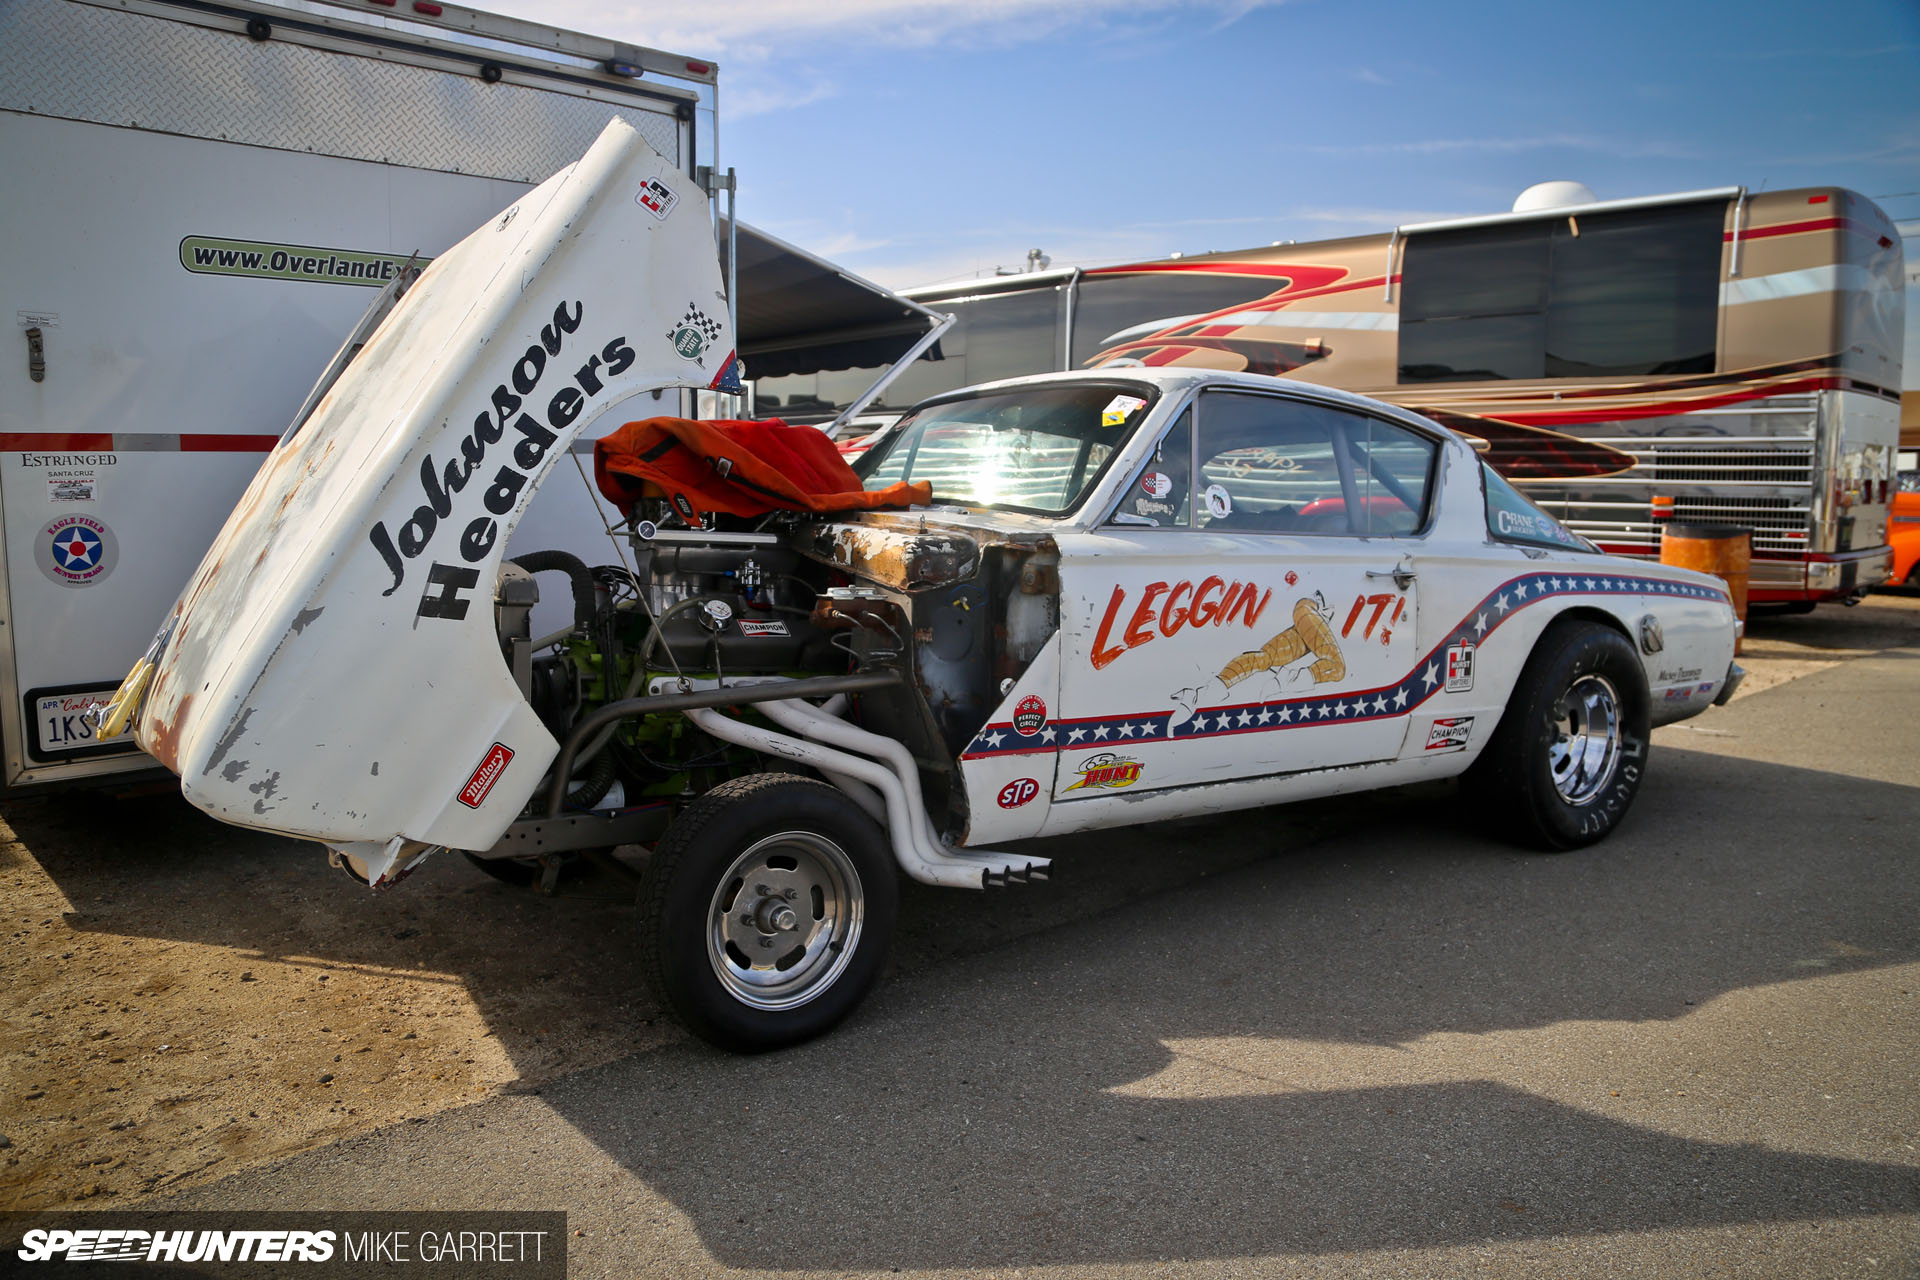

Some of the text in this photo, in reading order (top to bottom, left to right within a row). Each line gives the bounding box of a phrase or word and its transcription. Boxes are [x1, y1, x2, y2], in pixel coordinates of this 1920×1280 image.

[677, 329, 694, 351] QUAKER
[685, 336, 699, 353] STATE
[370, 300, 582, 597] Johnson
[415, 336, 636, 622] Headers
[48, 517, 105, 535] EAGLE FIELD
[1341, 593, 1407, 647] IT!
[42, 701, 58, 710] APR
[1020, 720, 1038, 728] CIRCLE
[1431, 726, 1470, 739] CHAMPION
[466, 750, 504, 803] Mallory
[1083, 763, 1145, 787] HUNT
[1001, 779, 1035, 804] STP
